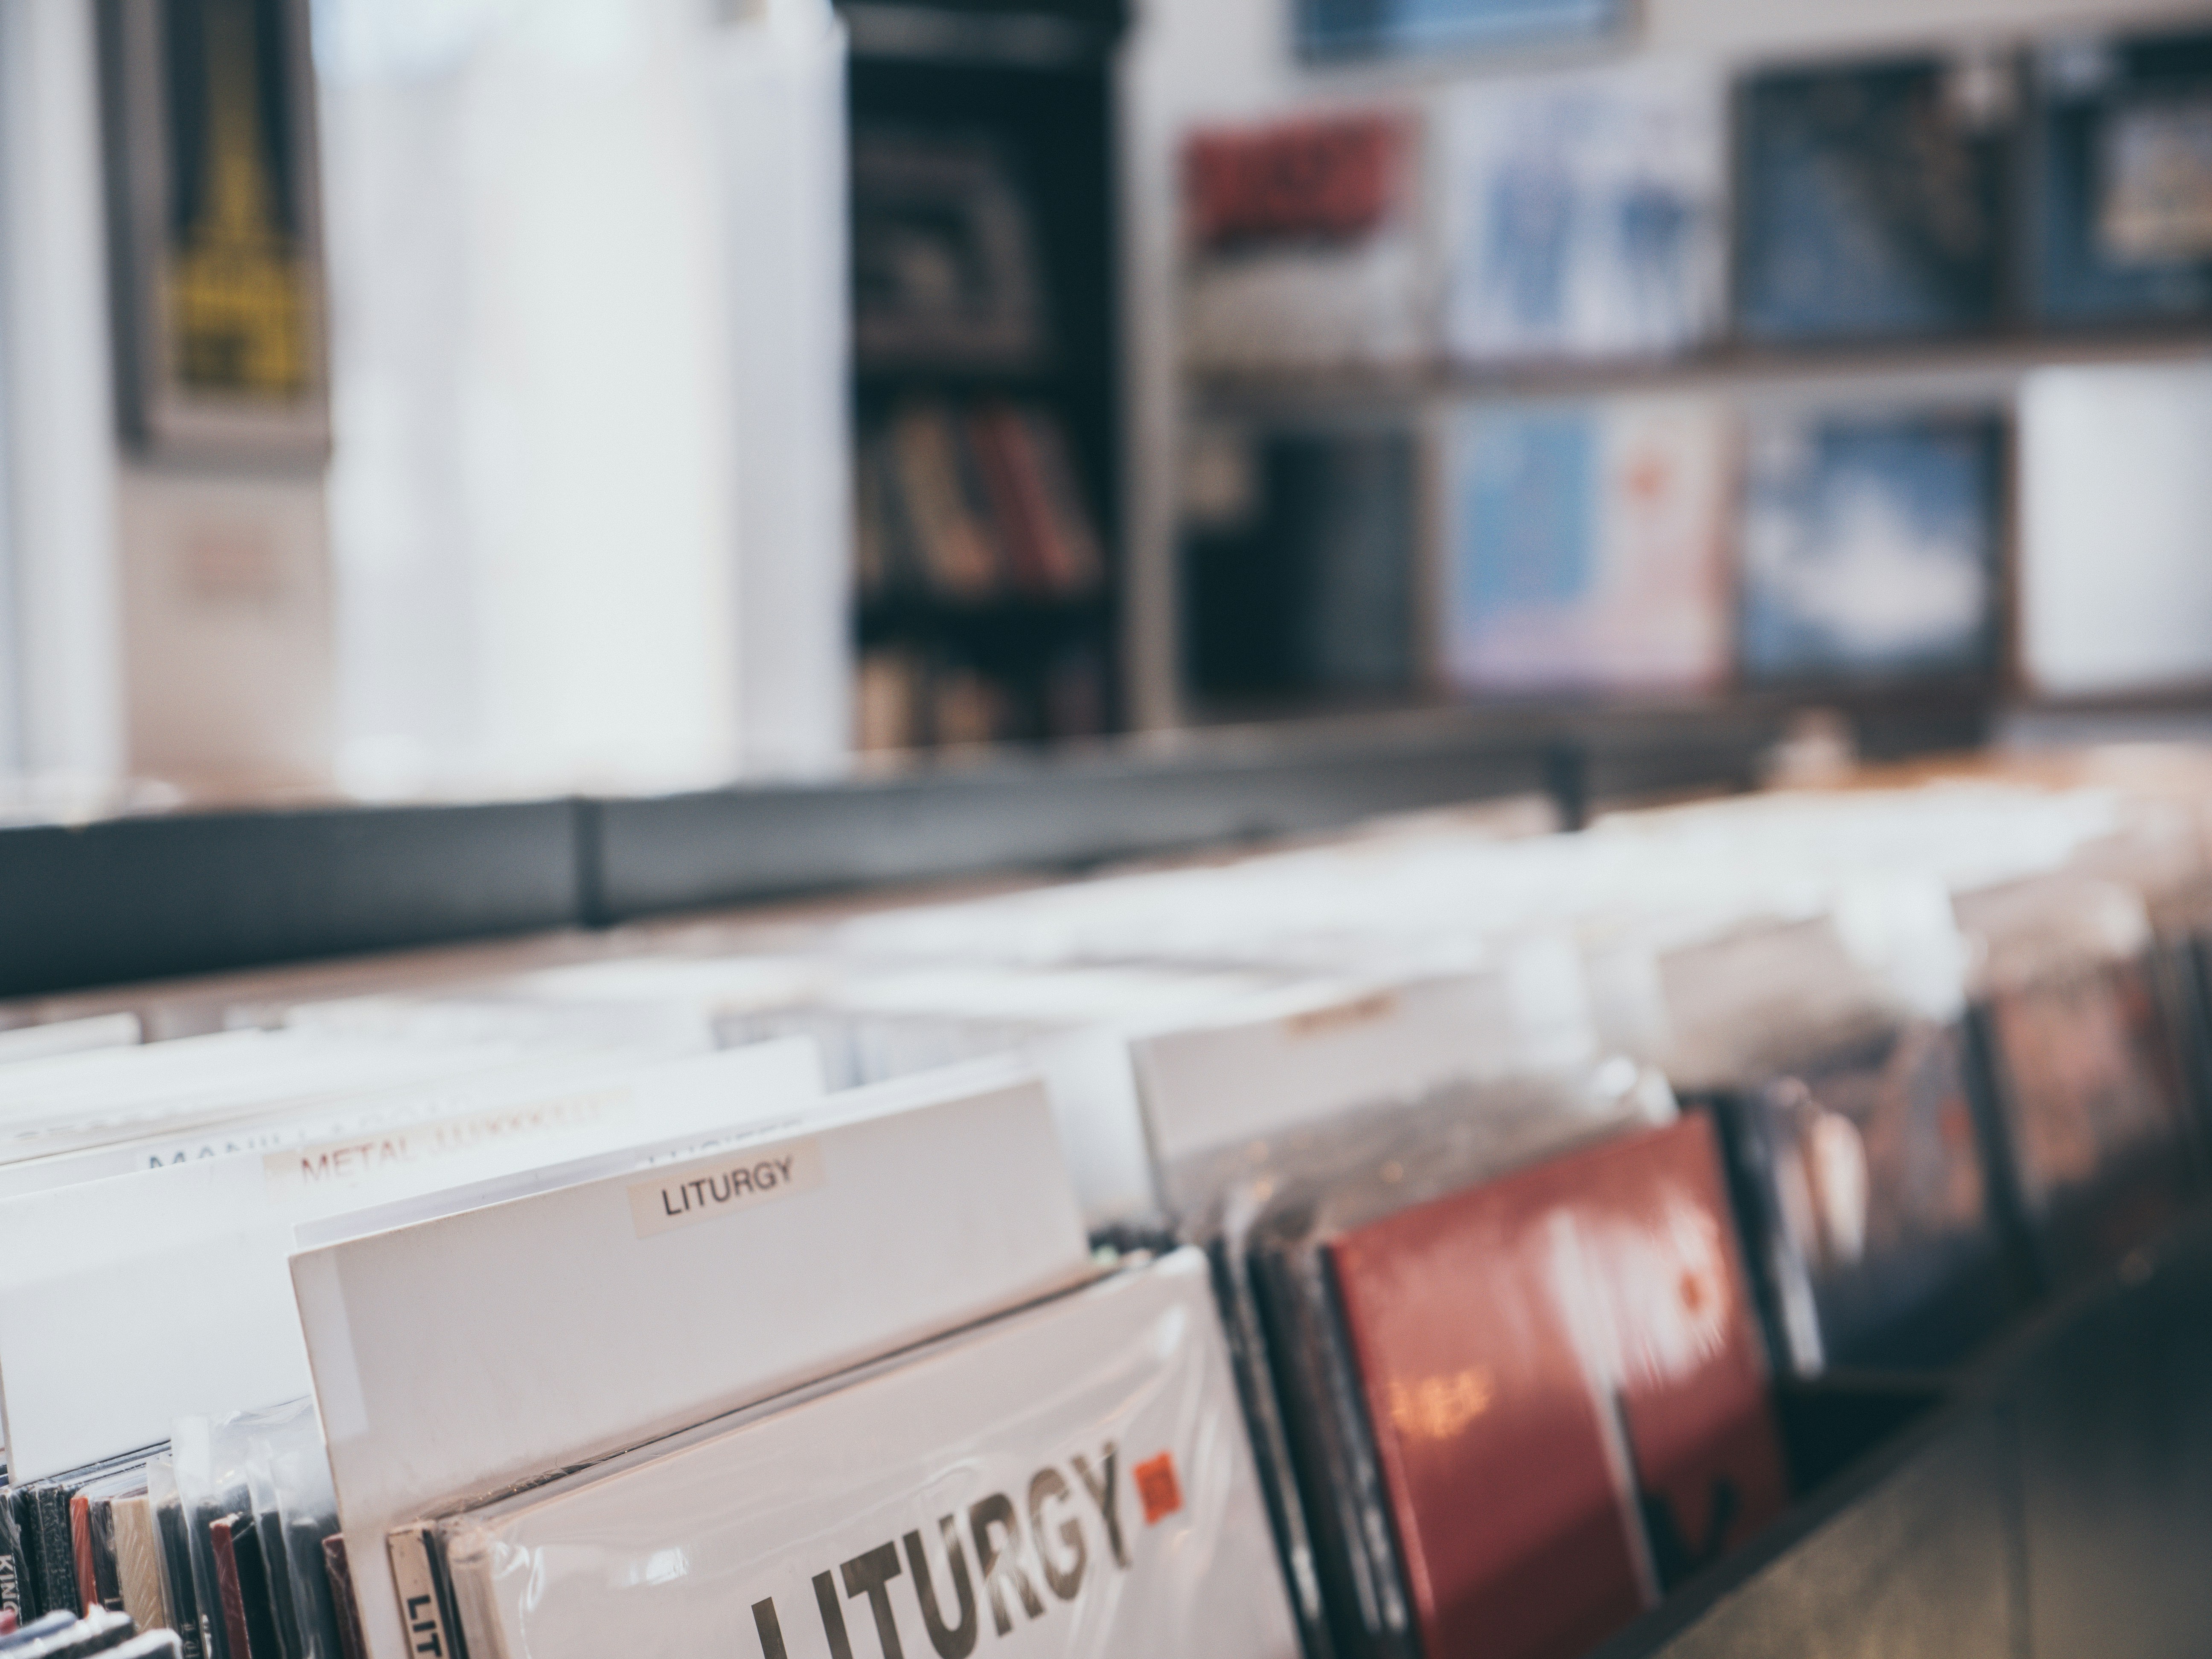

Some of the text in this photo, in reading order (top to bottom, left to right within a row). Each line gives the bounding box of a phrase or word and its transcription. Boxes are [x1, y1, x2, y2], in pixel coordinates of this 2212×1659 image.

[300, 1136, 418, 1184] METAL
[662, 1157, 794, 1217] LITURGY
[407, 1594, 442, 1657] LIT
